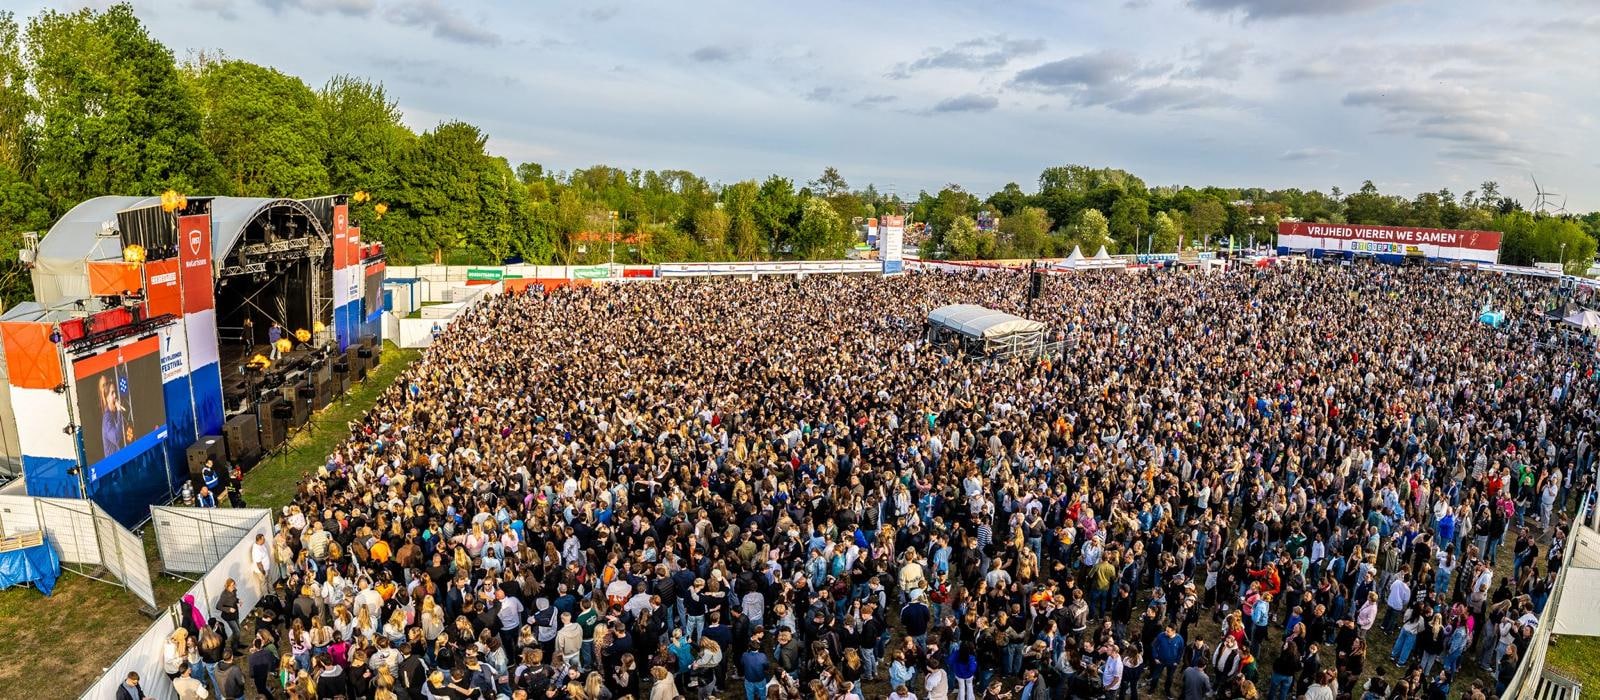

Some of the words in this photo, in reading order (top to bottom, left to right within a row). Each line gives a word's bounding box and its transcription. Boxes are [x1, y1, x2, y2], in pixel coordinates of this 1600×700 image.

[1307, 226, 1353, 238] VRIJHEID
[1355, 228, 1394, 240] VIEREN
[1396, 230, 1414, 241] WE
[1415, 231, 1457, 243] SAMEN
[161, 360, 183, 373] FESTIVAL
